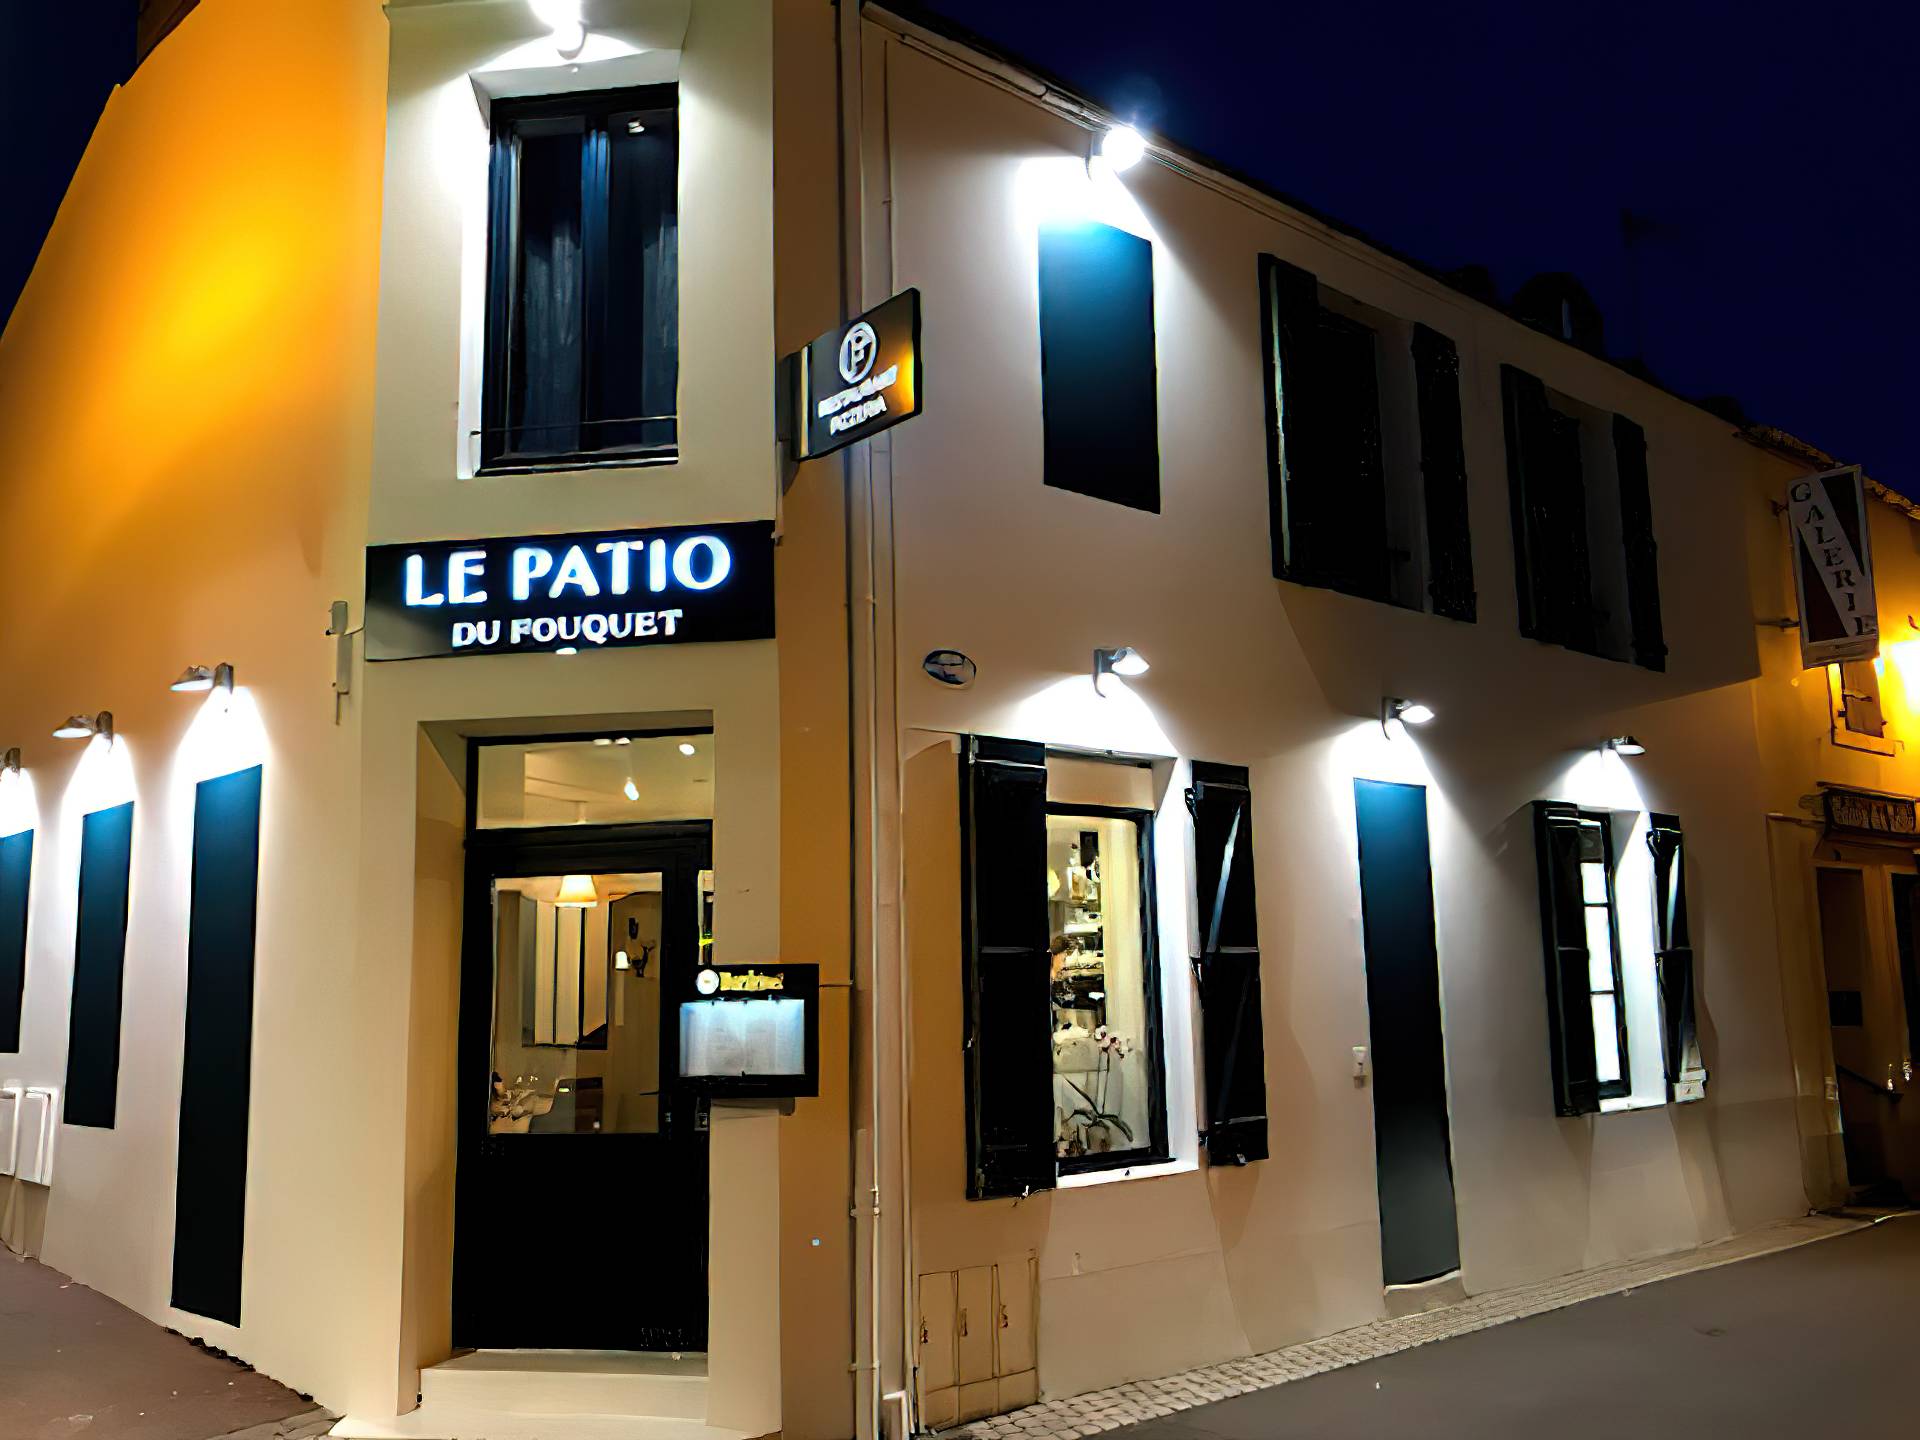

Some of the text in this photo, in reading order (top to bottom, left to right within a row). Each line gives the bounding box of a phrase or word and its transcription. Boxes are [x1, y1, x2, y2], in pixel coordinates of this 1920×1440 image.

[405, 535, 731, 605] LE PATIO
[1791, 482, 1876, 635] GALERIE
[451, 609, 683, 648] DU FOUQUET
